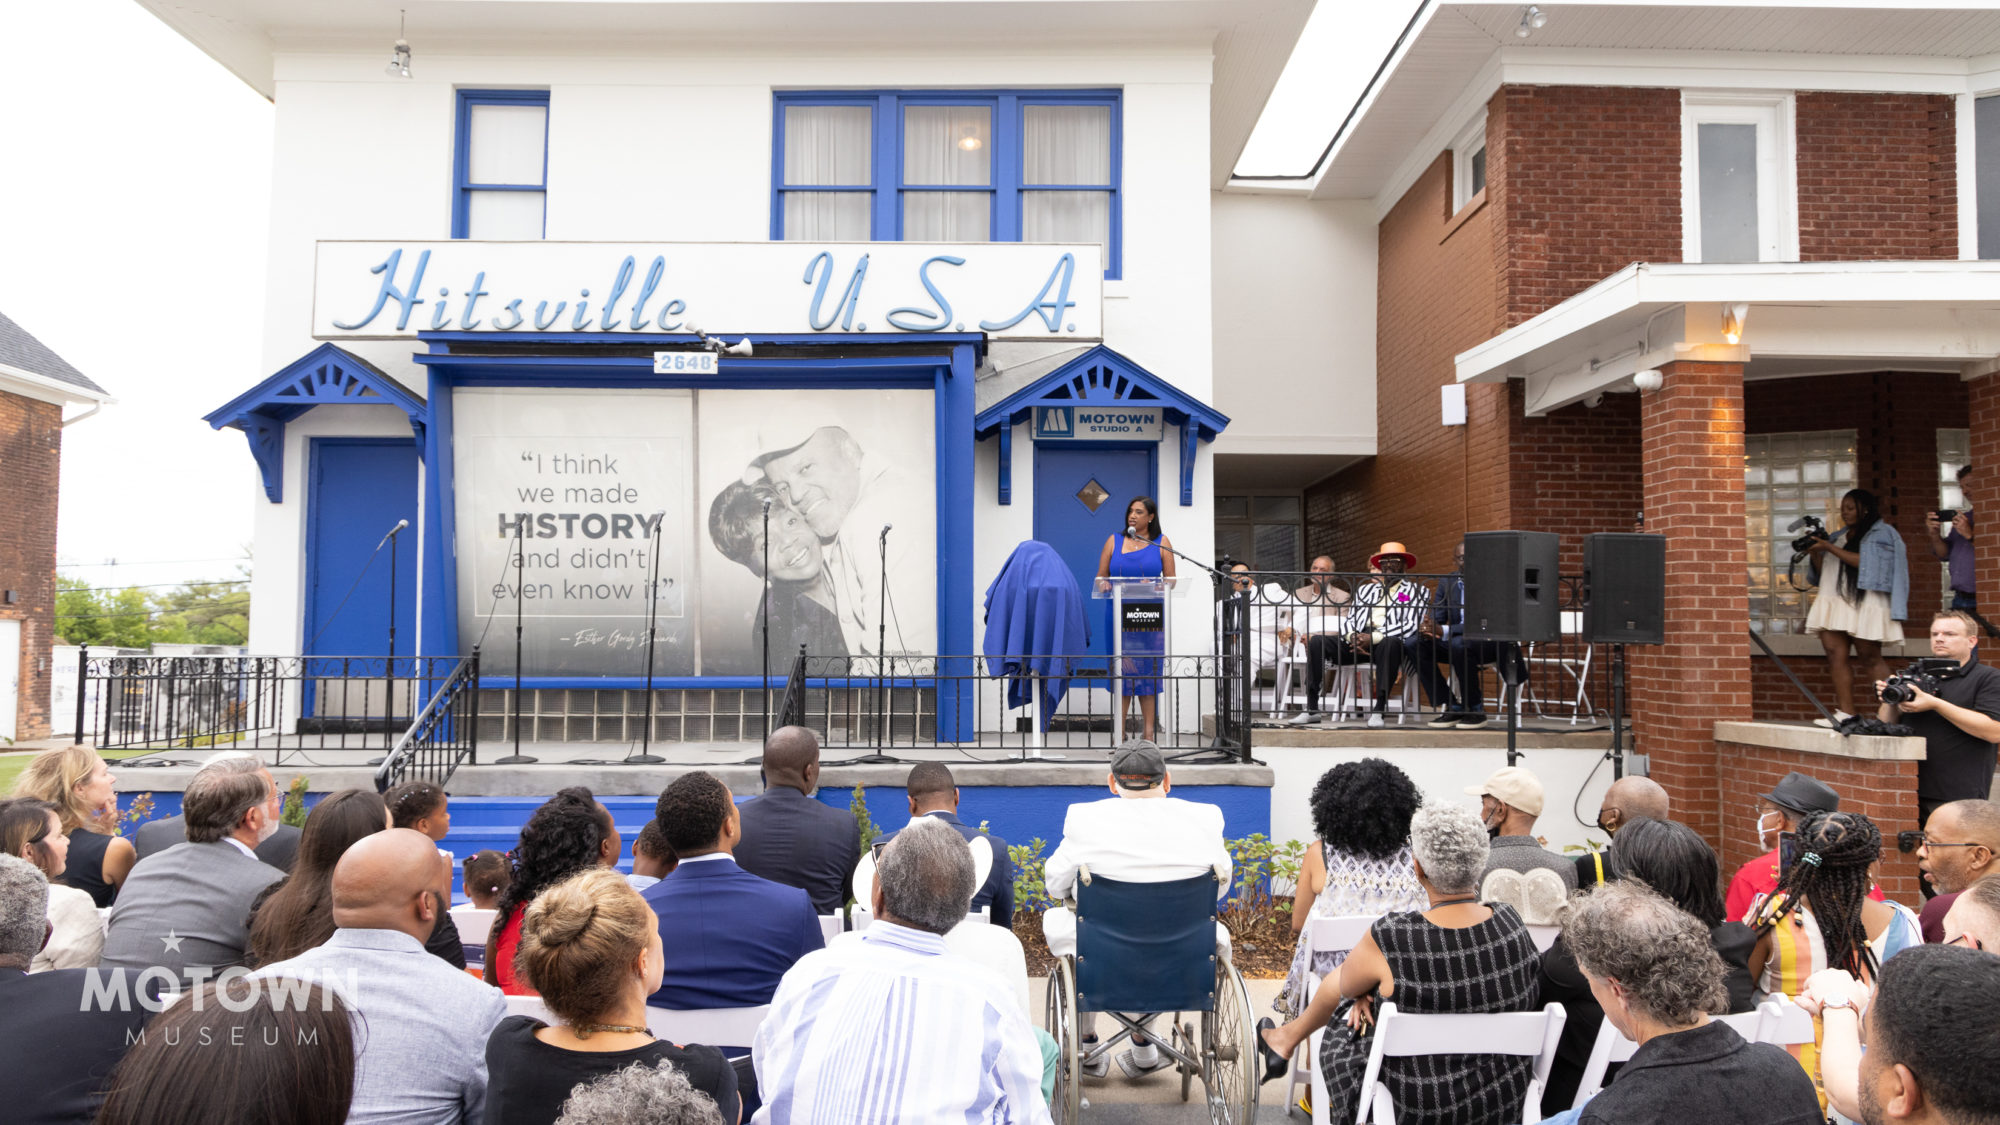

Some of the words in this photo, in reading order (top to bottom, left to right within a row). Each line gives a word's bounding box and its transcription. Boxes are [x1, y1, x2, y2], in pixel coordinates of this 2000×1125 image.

[332, 248, 687, 332] Hitsville
[803, 251, 1076, 333] U.S.A.
[661, 355, 711, 370] 2648
[1079, 414, 1154, 424] MOTOWN
[552, 453, 618, 474] think
[517, 487, 554, 503] we
[565, 482, 638, 503] made
[498, 513, 660, 539] HISTORY
[511, 548, 560, 568] and
[570, 548, 646, 568] didn't
[492, 583, 553, 600] even
[564, 579, 633, 600] know
